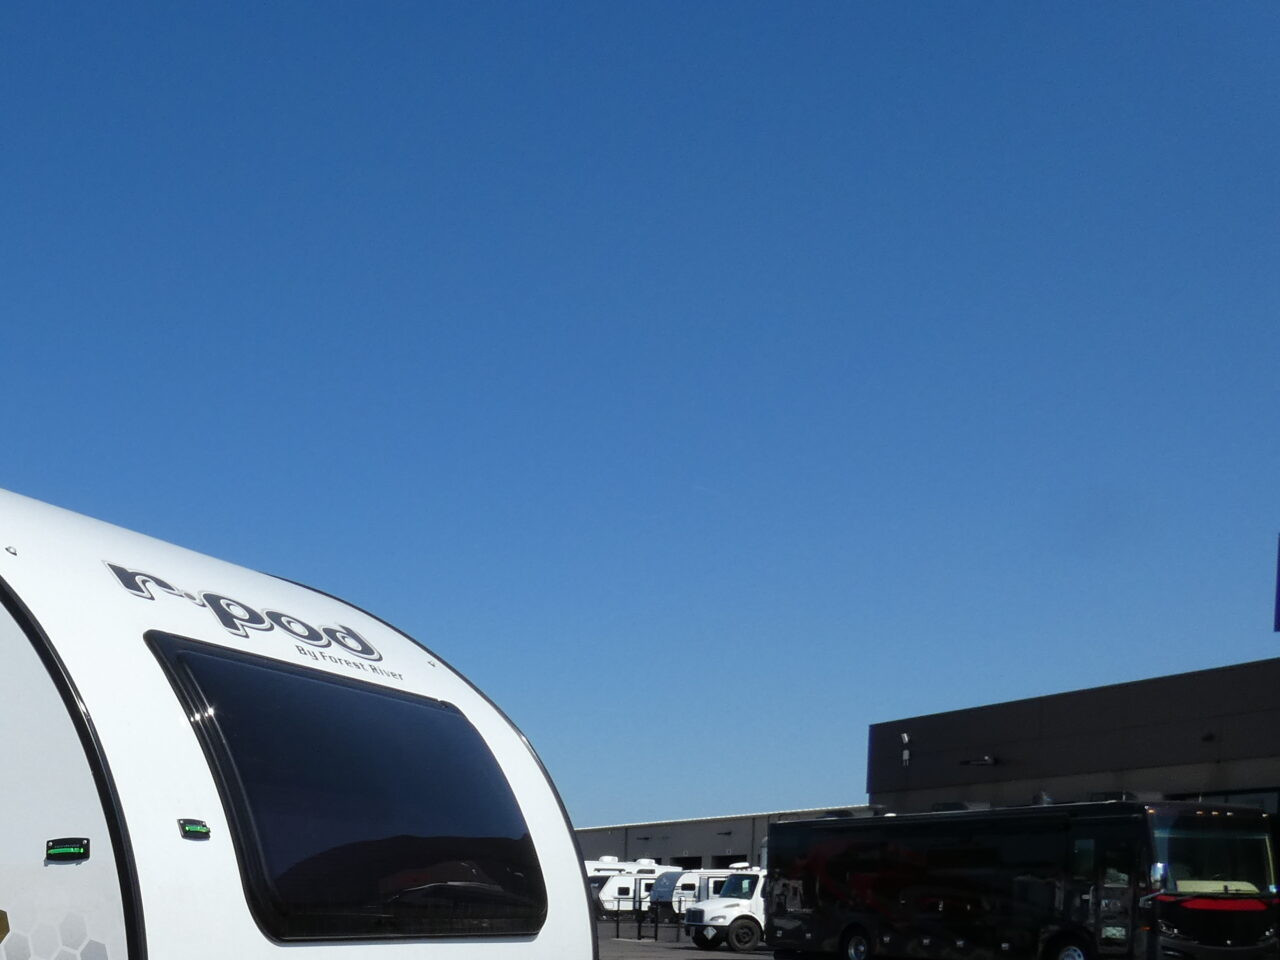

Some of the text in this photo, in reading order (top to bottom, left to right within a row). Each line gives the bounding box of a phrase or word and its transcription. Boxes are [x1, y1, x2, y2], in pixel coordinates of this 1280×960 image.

[295, 644, 405, 681] By Forest River
